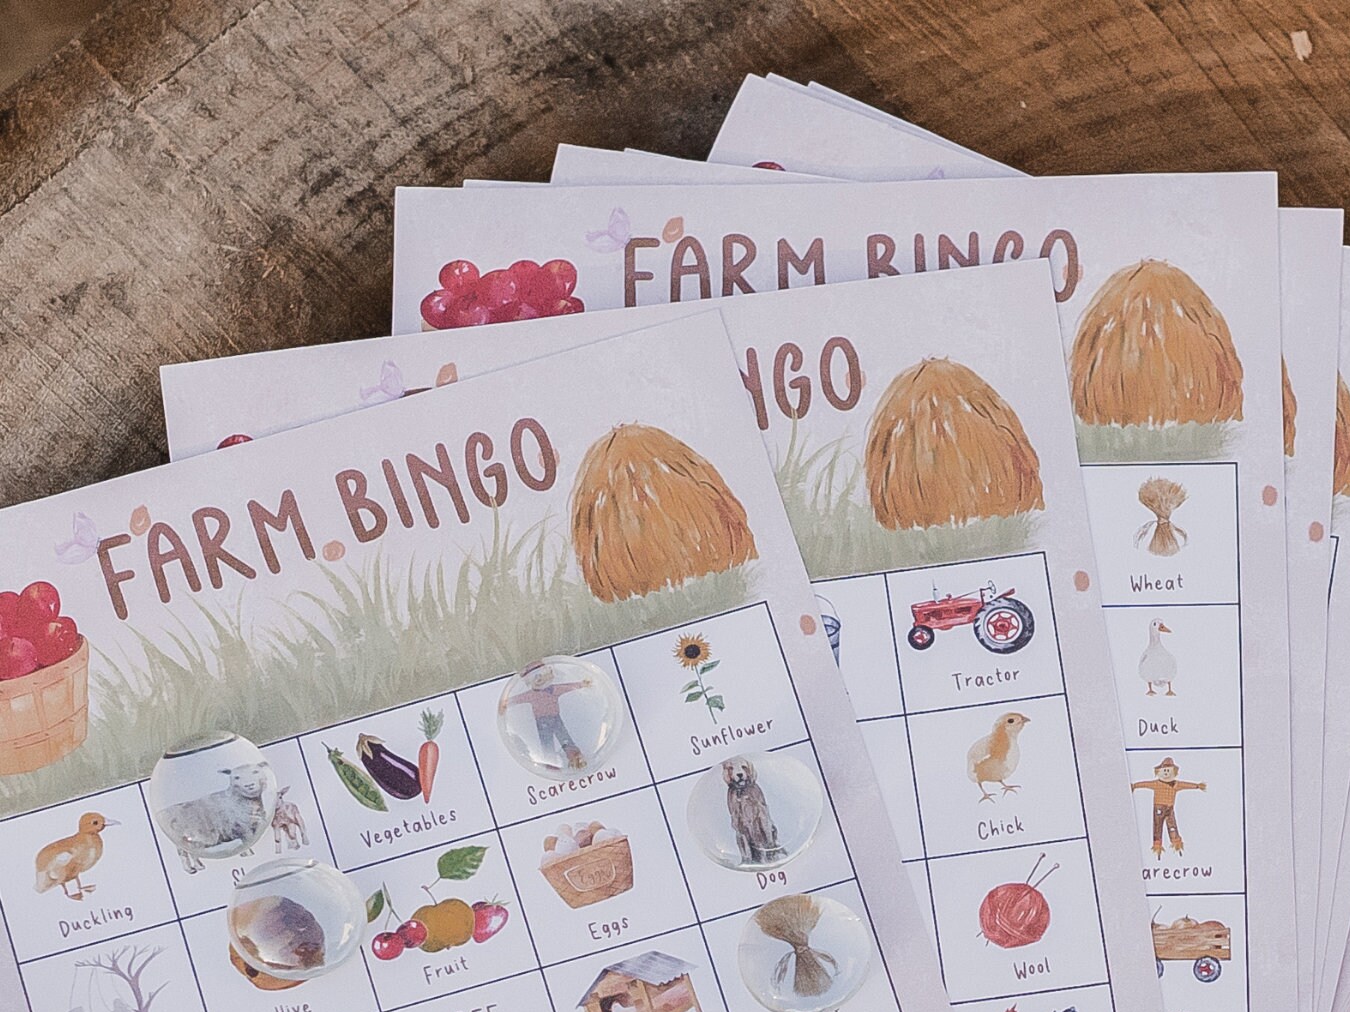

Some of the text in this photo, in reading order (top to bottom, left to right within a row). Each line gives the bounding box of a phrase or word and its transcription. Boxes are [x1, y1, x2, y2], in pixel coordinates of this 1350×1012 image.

[624, 233, 826, 308] FARM
[97, 417, 557, 621] FARM BINGO
[1130, 574, 1183, 592] Wheat
[952, 668, 1019, 691] Tractor
[692, 719, 774, 755] Sunflower
[1139, 717, 1178, 736] Duck
[527, 769, 618, 805] Scarecrow
[361, 810, 457, 849] Vegetables
[978, 816, 1024, 840] Chick
[757, 869, 788, 890] Dog
[1143, 867, 1212, 880] arecrow
[59, 908, 135, 939] Duckling
[588, 918, 628, 940] Eggs
[423, 957, 468, 985] Fruit
[1014, 957, 1050, 979] Wool
